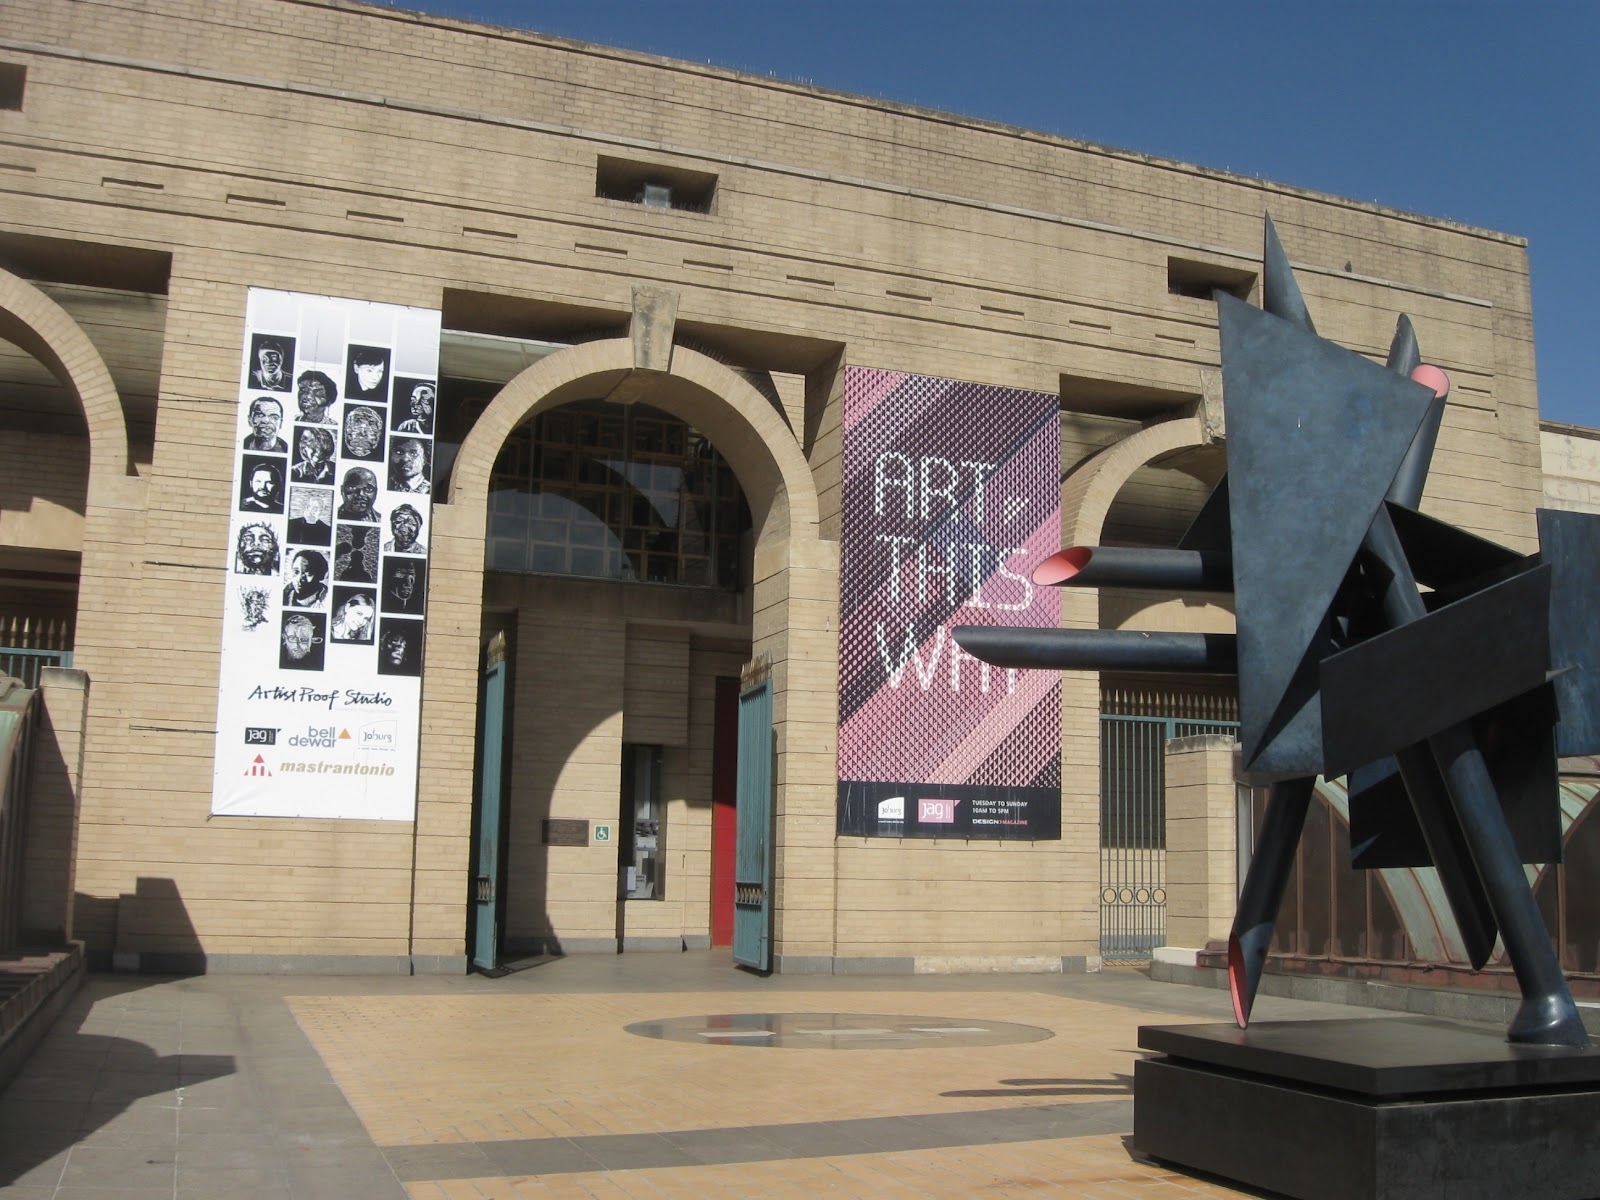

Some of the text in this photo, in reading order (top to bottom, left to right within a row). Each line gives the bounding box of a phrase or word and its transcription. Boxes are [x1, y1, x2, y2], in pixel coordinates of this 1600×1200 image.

[875, 451, 998, 524] ART
[875, 534, 1033, 612] THIS
[876, 621, 1017, 694] WH
[247, 685, 392, 710] Artist Proof Studio
[288, 735, 337, 748] dewar
[308, 726, 336, 739] bell
[280, 761, 395, 776] mastrantonio
